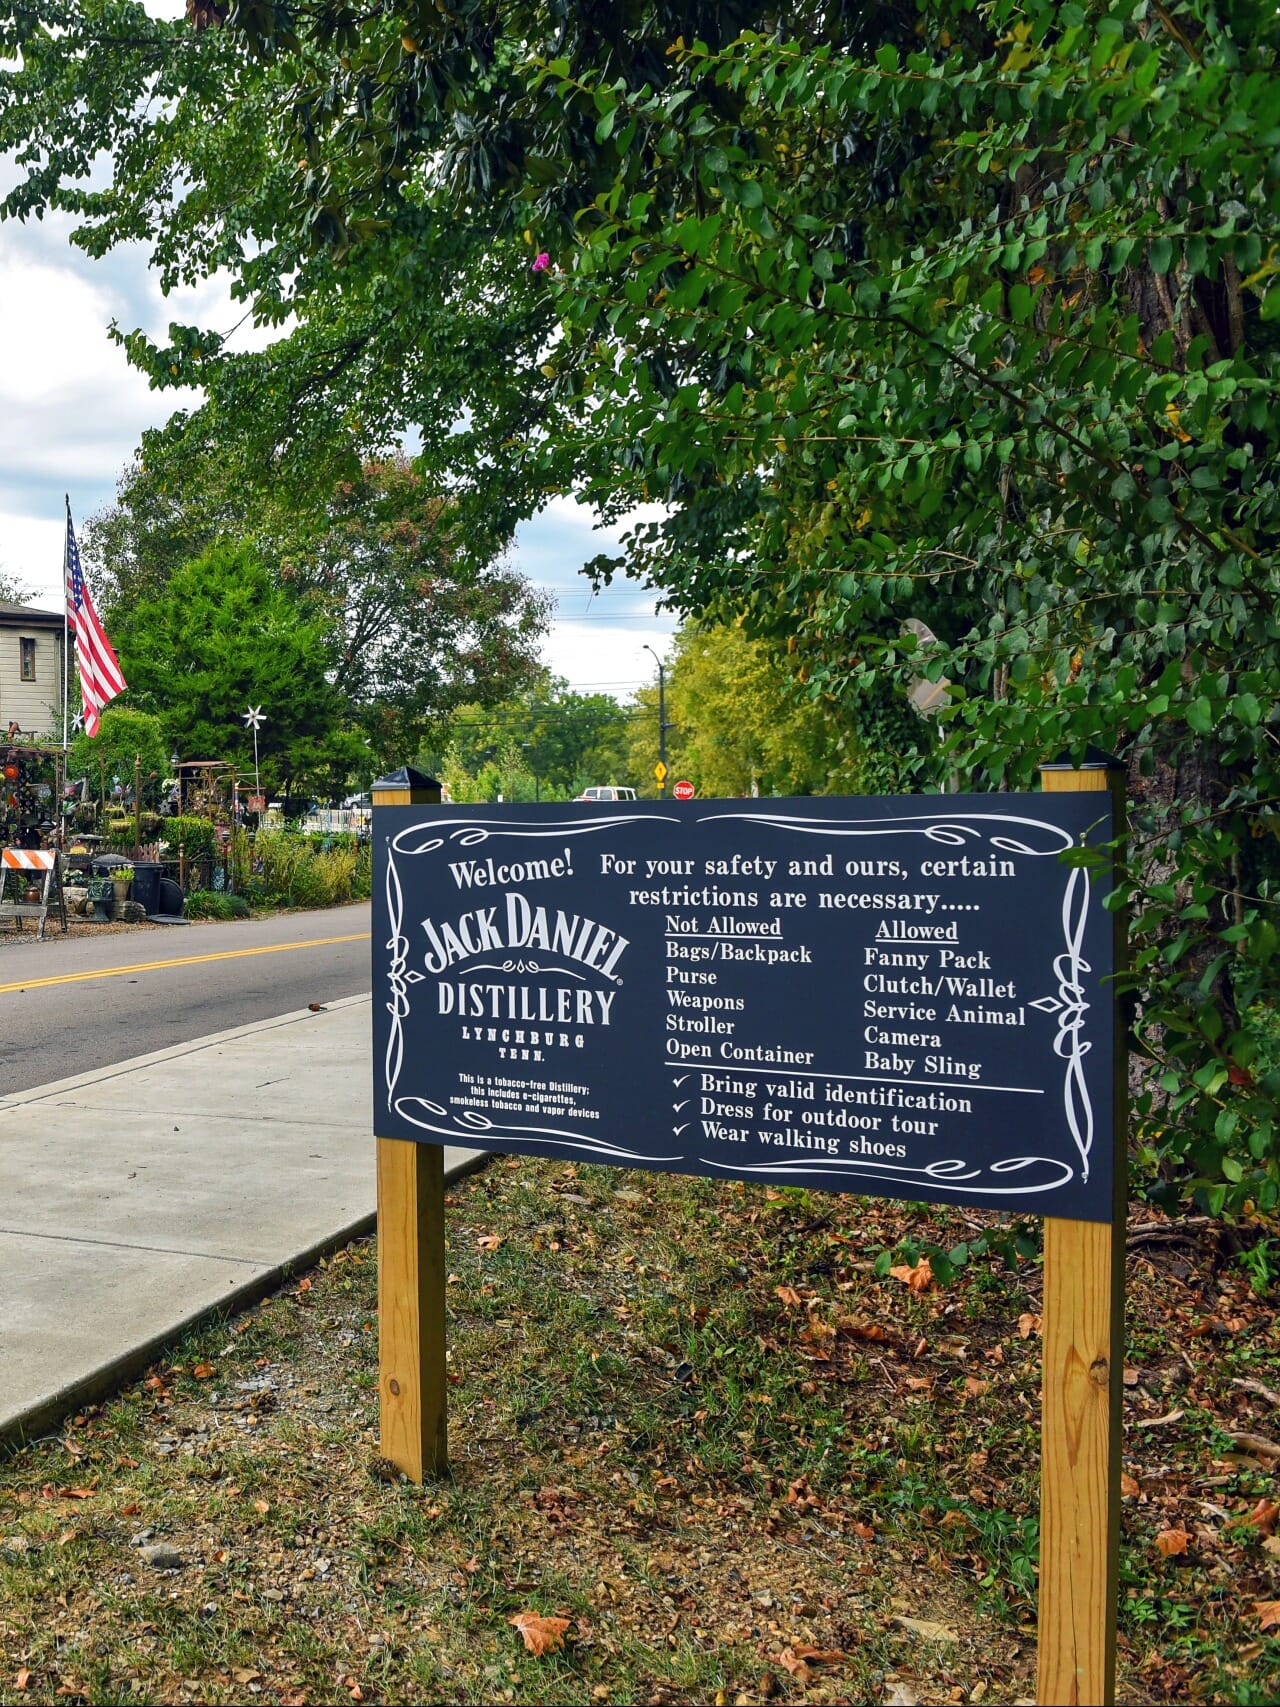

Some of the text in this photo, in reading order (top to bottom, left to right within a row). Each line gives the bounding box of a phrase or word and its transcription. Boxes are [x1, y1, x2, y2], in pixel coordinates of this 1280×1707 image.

[675, 786, 694, 796] STOP
[448, 848, 573, 889] Welcome!
[600, 854, 1015, 880] For your safety and ours, certain
[630, 884, 980, 914] restrictions are necessary.....
[421, 892, 630, 981] JACK DANIEL
[666, 915, 781, 935] Not Allowed
[875, 920, 958, 939] Allowed
[666, 941, 812, 964] Bags/Backpack
[864, 948, 990, 970] Fanny Pack
[667, 967, 717, 984] Purse
[864, 974, 1016, 998] Clutch/Wallet
[439, 982, 616, 1025] DISTILLERY
[667, 990, 744, 1011] Weapons
[667, 1014, 734, 1034] Stroller
[864, 1000, 1025, 1025] Service Animal
[463, 1027, 584, 1048] LYNCHBURG
[865, 1026, 941, 1047] Camera
[499, 1048, 544, 1061] TENN.
[667, 1038, 814, 1064] Open Container
[865, 1052, 981, 1079] Baby Sling
[458, 1073, 590, 1096] This is a tobacco-free Distillery;
[470, 1085, 577, 1107] this includes e-cigarettes,
[701, 1074, 971, 1112] Bring valid identification
[449, 1095, 600, 1119] smokeless tobacco and vapor devices
[701, 1097, 938, 1135] Dress for outdoor tour
[701, 1121, 905, 1157] Wear walking shoes
